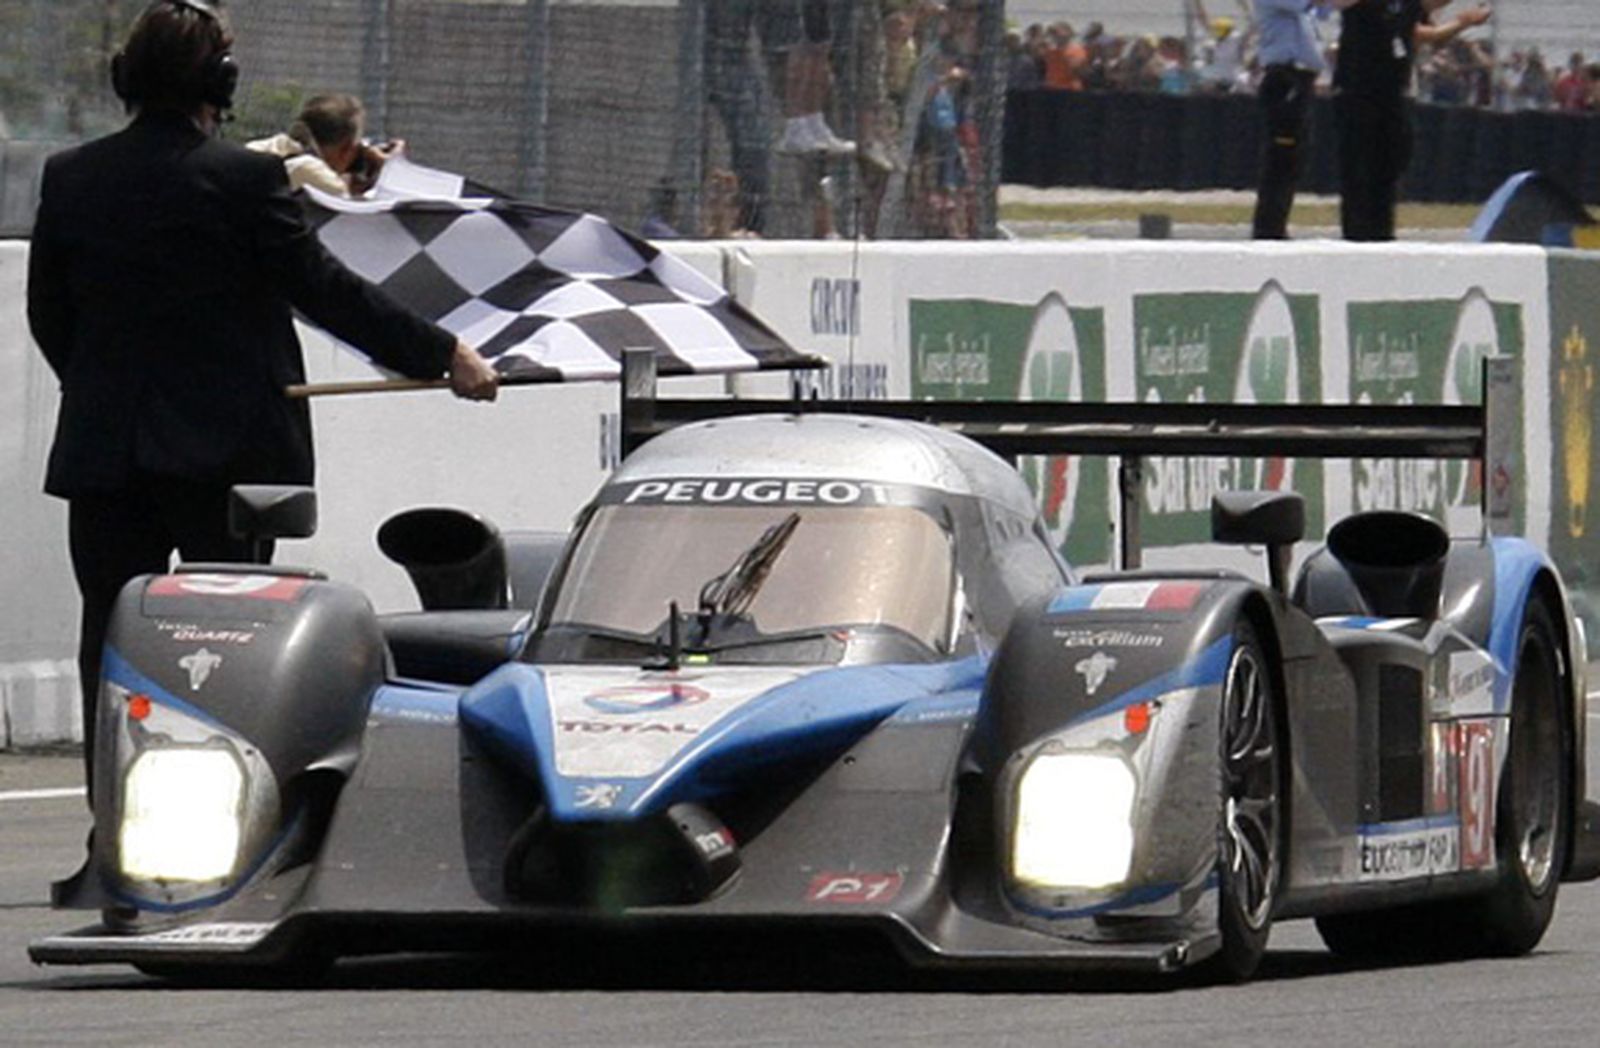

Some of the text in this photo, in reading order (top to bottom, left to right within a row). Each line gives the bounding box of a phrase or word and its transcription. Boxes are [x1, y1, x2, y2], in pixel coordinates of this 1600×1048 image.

[624, 481, 891, 503] PEUGEOT
[557, 720, 698, 733] TOTAL
[815, 878, 890, 900] P1
